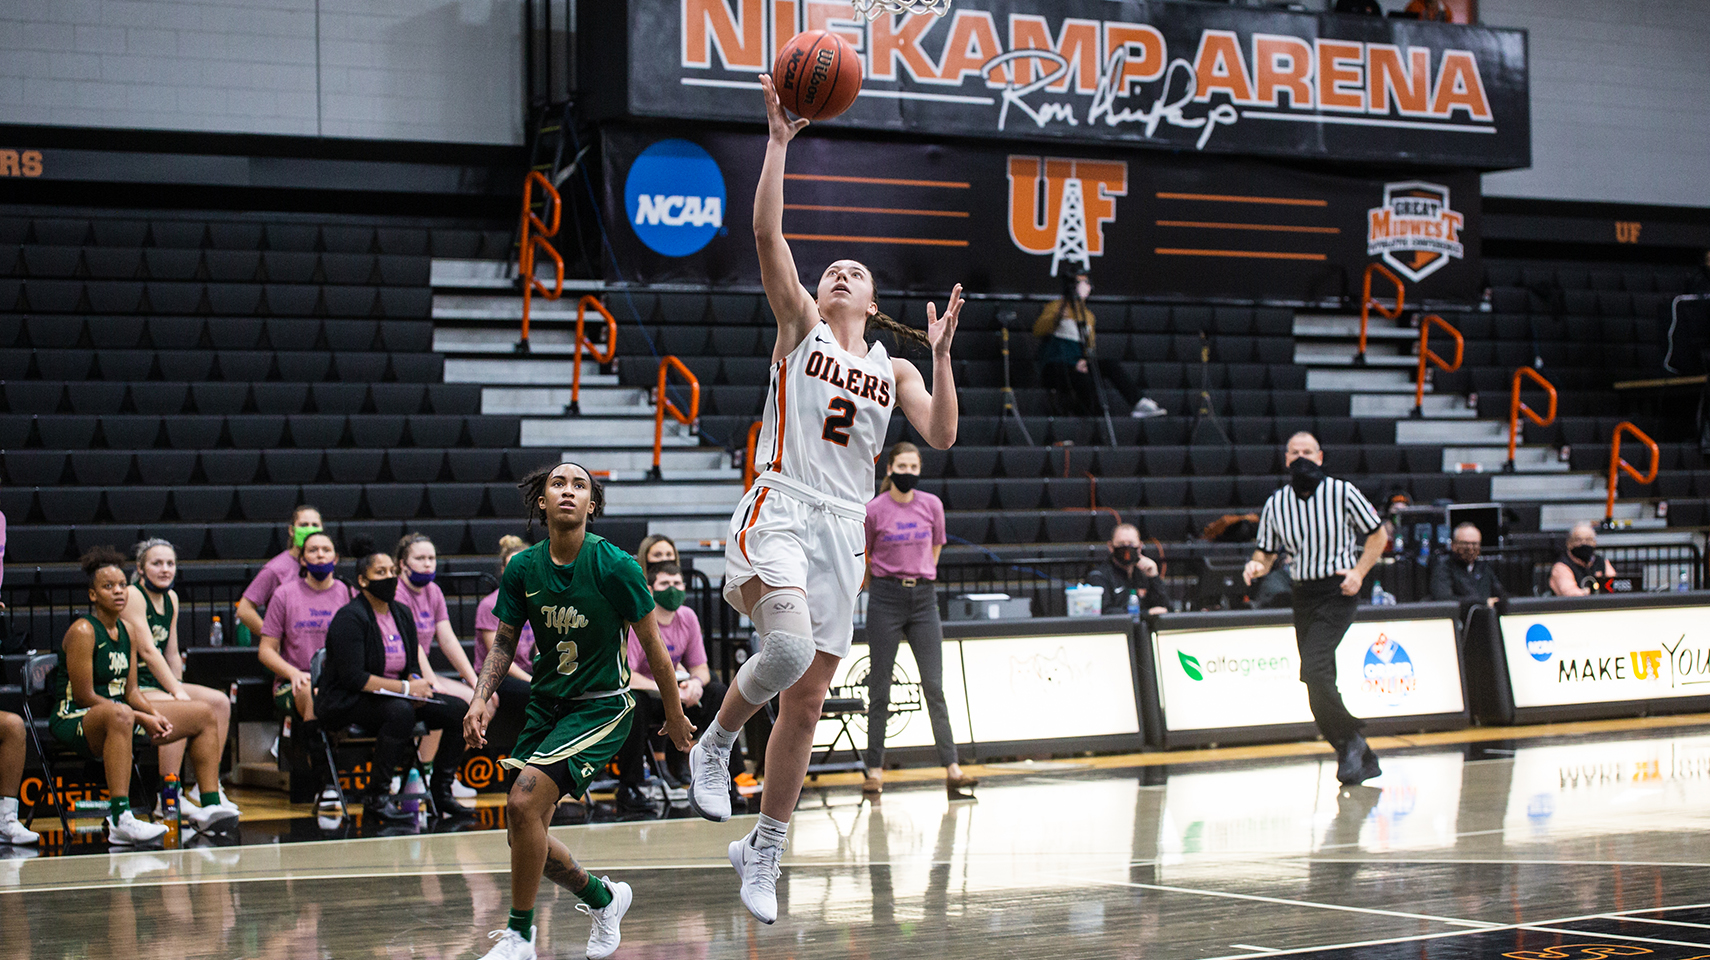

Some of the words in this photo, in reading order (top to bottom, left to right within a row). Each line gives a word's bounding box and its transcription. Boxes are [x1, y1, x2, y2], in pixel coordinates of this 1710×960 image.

[783, 47, 804, 90] NCAA
[804, 48, 835, 105] Wilson
[1193, 29, 1496, 122] ARENA
[635, 193, 723, 228] NCAA
[1006, 154, 1128, 256] UF
[1614, 221, 1643, 244] UF
[804, 350, 891, 408] OILERS
[821, 395, 858, 448] 2
[541, 604, 589, 634] Tiffin
[556, 640, 579, 676] 2
[1206, 655, 1290, 677] alfagreen
[1558, 656, 1626, 683] MAKE
